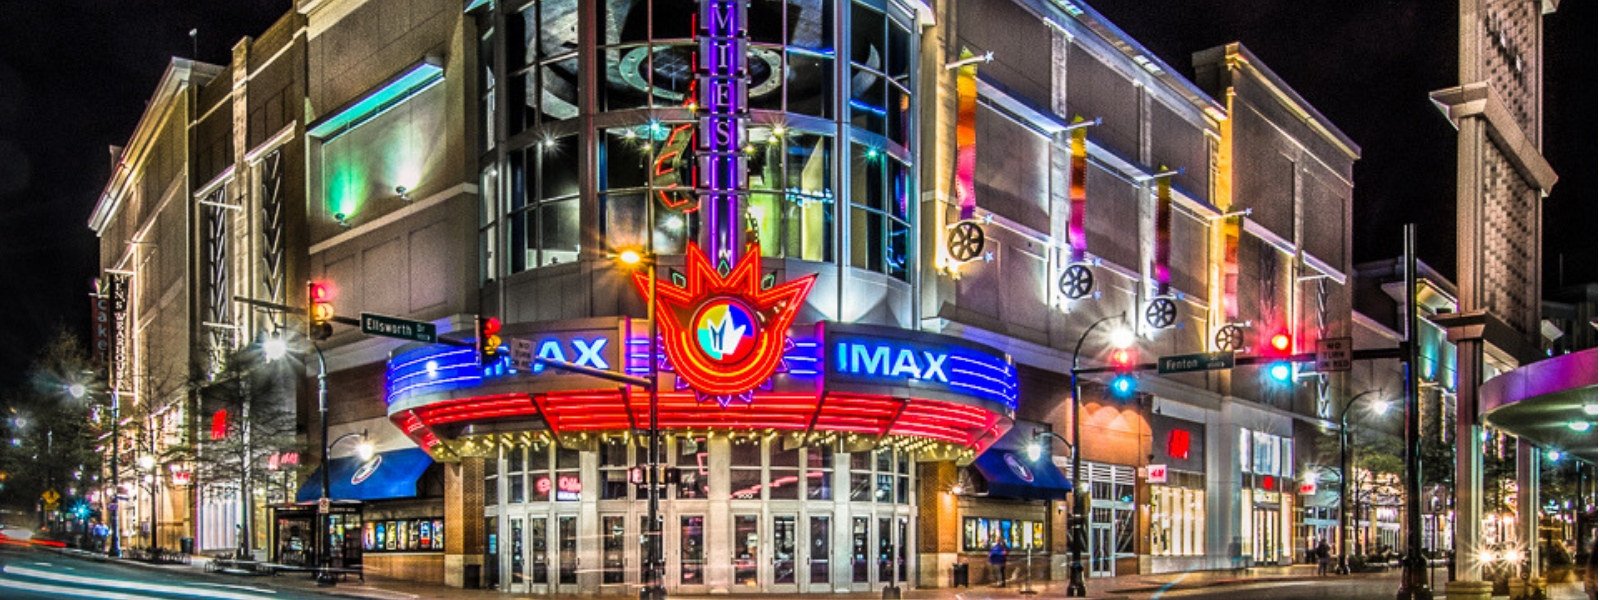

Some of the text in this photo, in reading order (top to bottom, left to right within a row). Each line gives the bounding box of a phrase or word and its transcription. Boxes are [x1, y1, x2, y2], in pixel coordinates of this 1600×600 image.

[367, 318, 412, 336] Ellsworth
[519, 341, 530, 349] NO
[1327, 341, 1341, 349] NO
[1323, 351, 1345, 359] TURN
[838, 342, 948, 382] IMAX
[1166, 359, 1198, 370] Fenton
